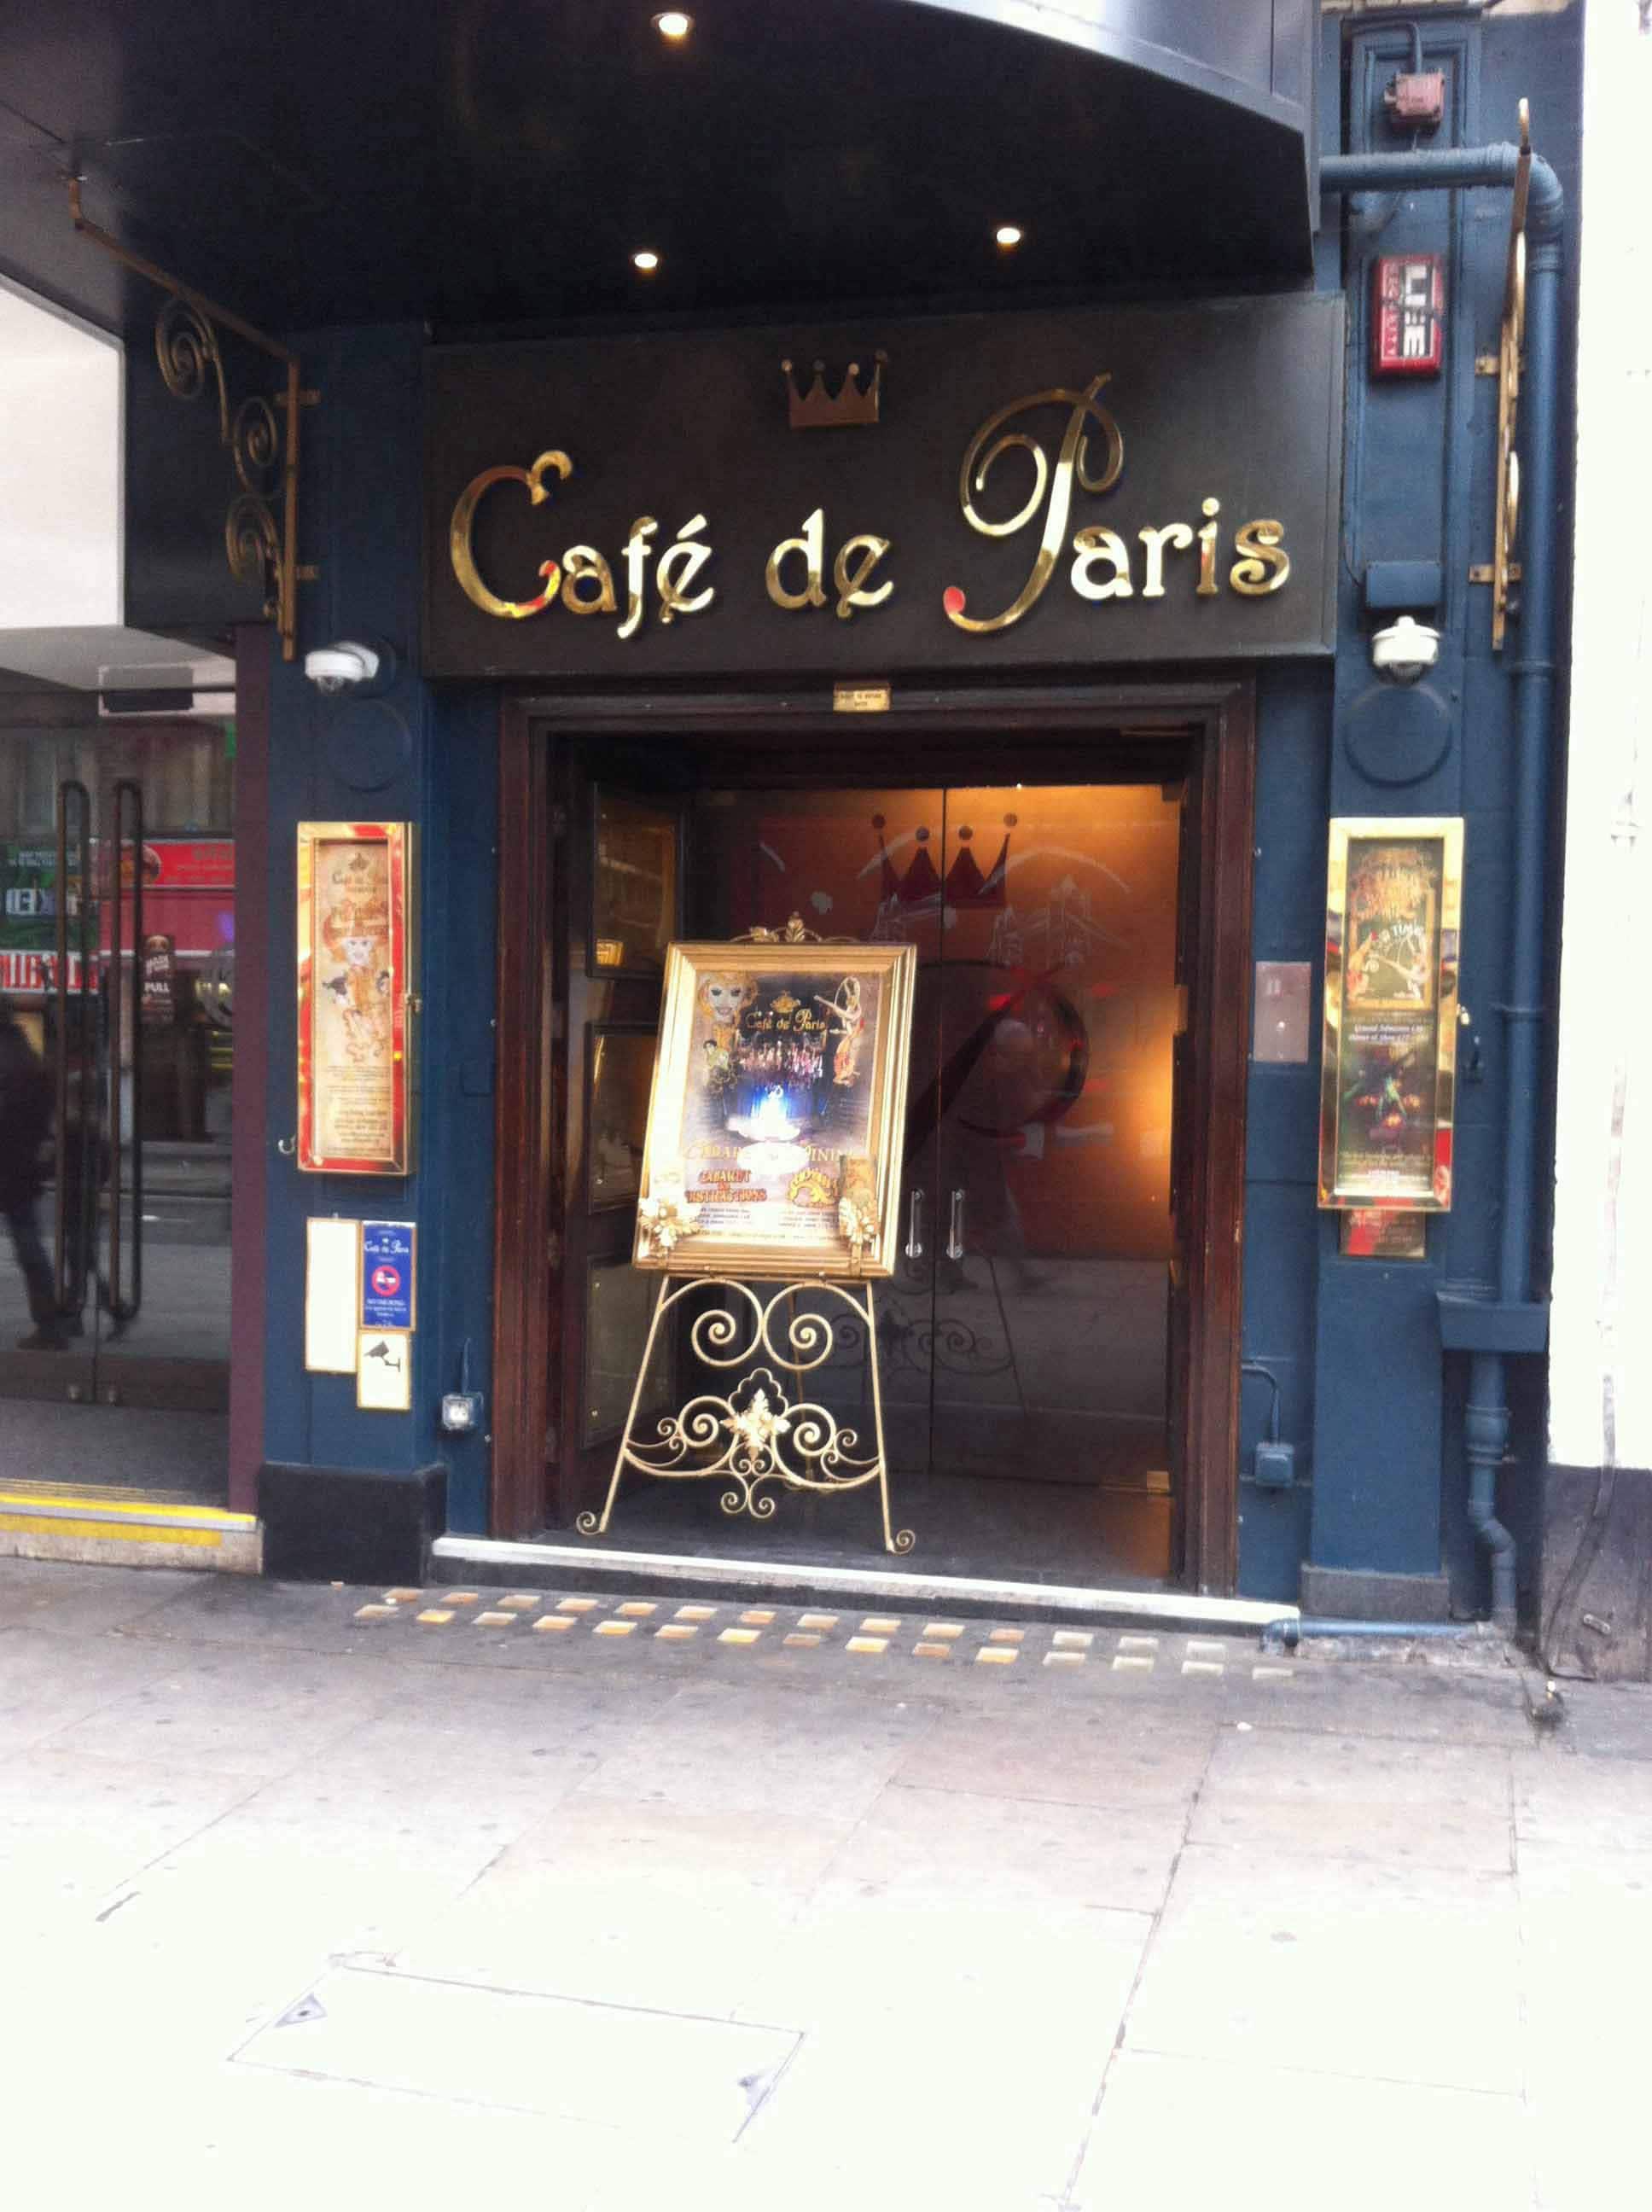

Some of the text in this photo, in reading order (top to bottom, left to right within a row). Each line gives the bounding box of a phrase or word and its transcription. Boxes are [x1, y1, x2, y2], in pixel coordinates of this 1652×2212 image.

[450, 373, 1291, 638] Café de Paris
